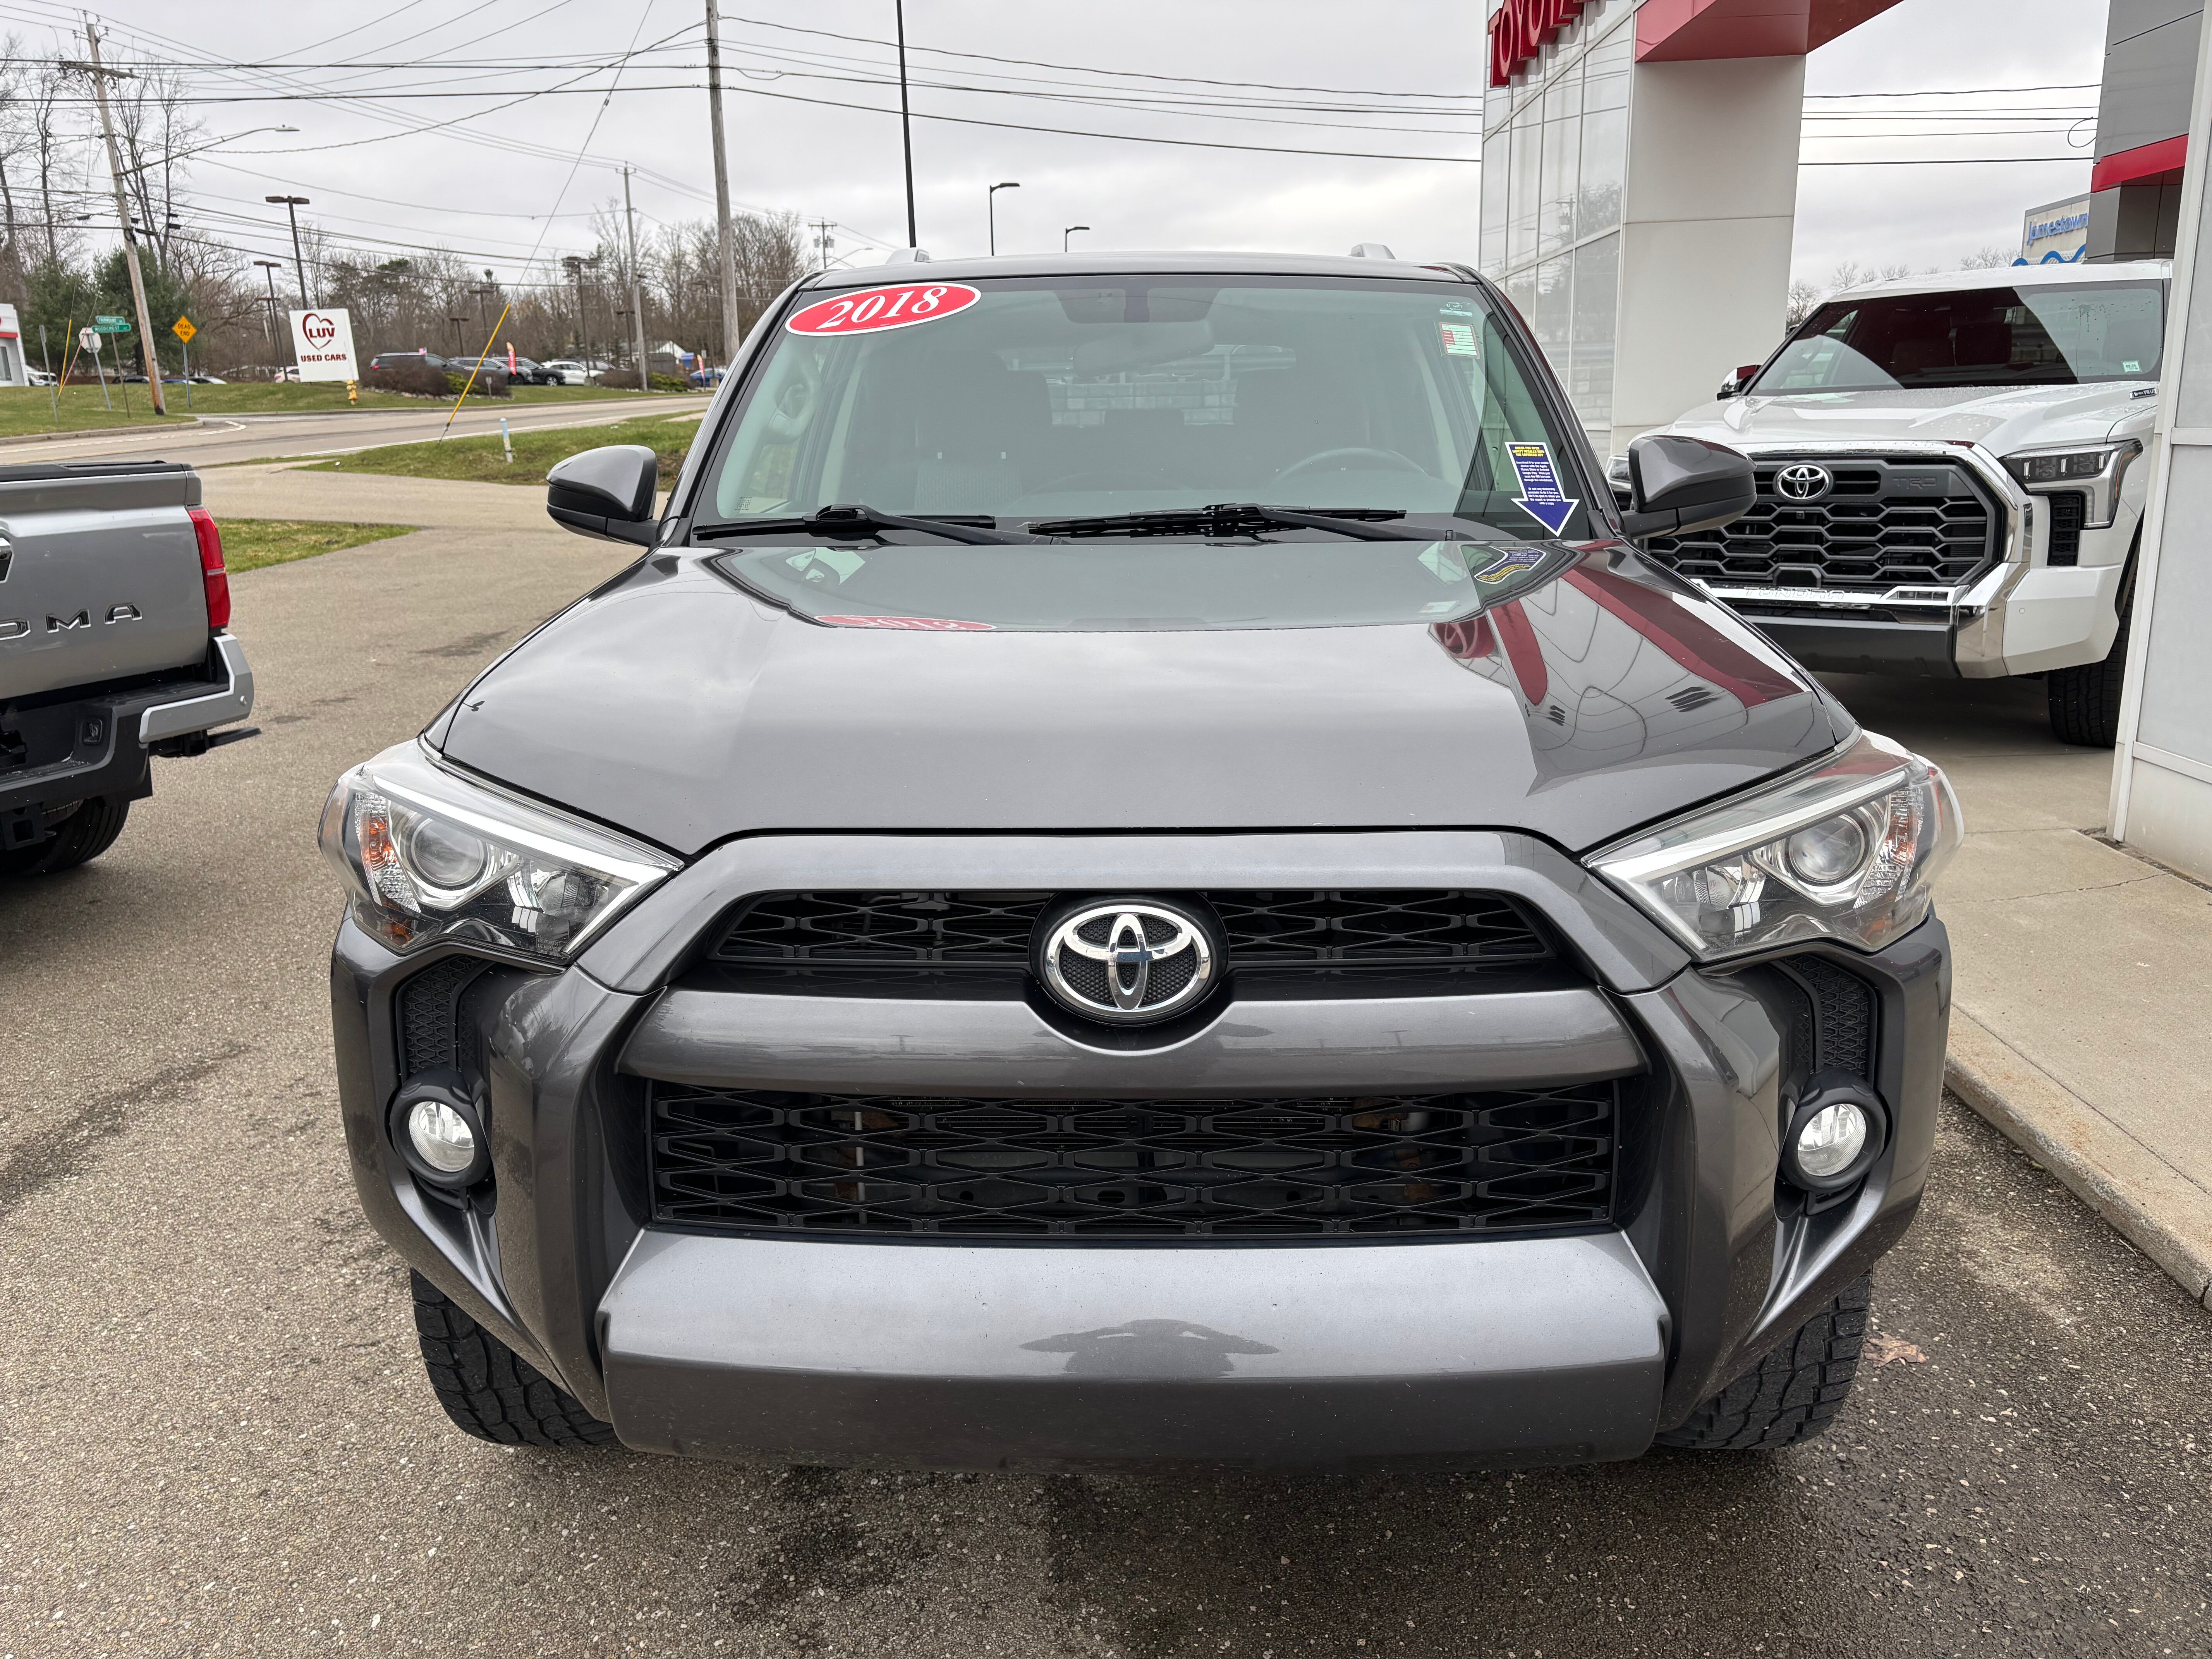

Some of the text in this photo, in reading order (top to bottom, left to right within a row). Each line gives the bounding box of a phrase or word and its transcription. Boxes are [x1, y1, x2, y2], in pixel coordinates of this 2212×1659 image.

[2027, 213, 2088, 246] Jamestown
[816, 287, 948, 329] 2018
[308, 328, 335, 338] LUV
[325, 353, 347, 361] CARS
[1893, 476, 1936, 489] TRD
[1744, 586, 1845, 599] TUNDRA
